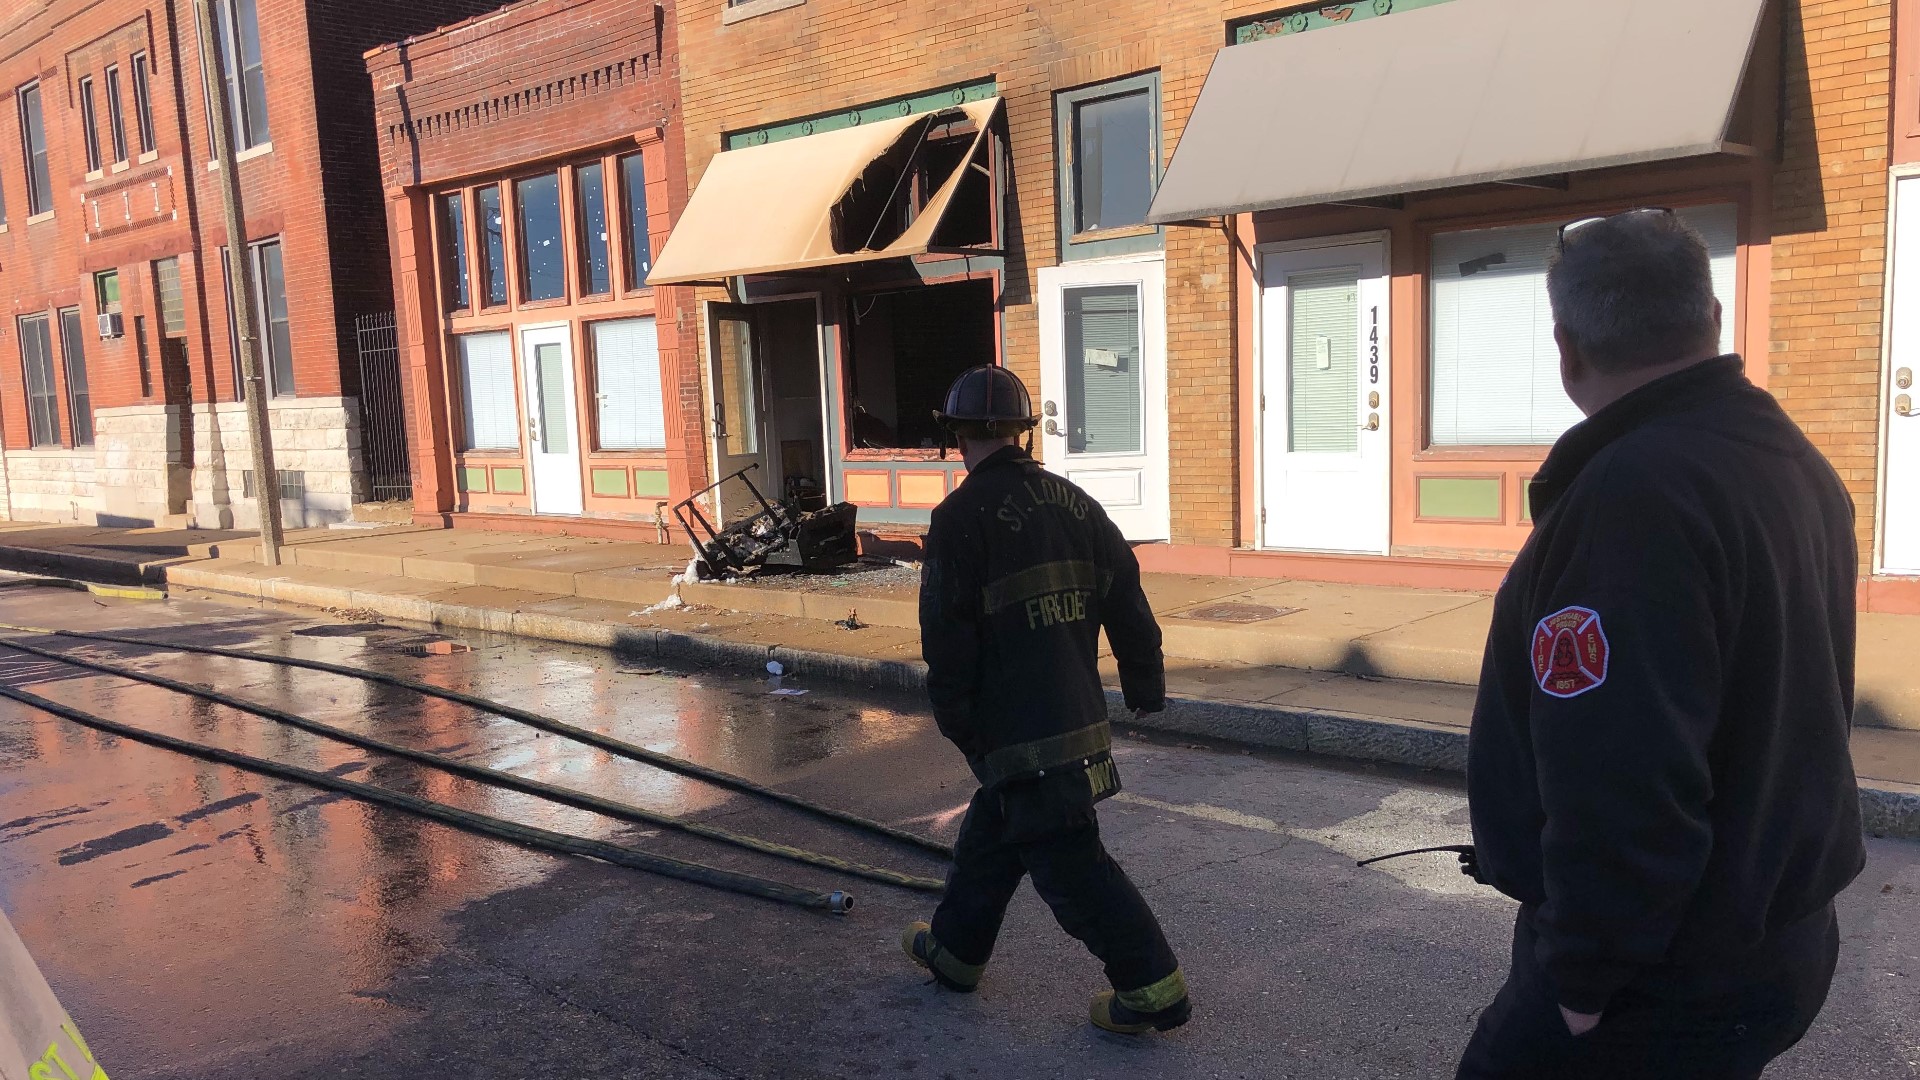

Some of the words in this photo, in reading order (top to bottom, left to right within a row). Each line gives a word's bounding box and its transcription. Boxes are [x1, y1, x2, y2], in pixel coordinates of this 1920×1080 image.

[1369, 305, 1379, 384] 1439
[1023, 478, 1090, 521] LOUIS
[1587, 633, 1597, 663] EMS
[1556, 680, 1575, 689] 1857
